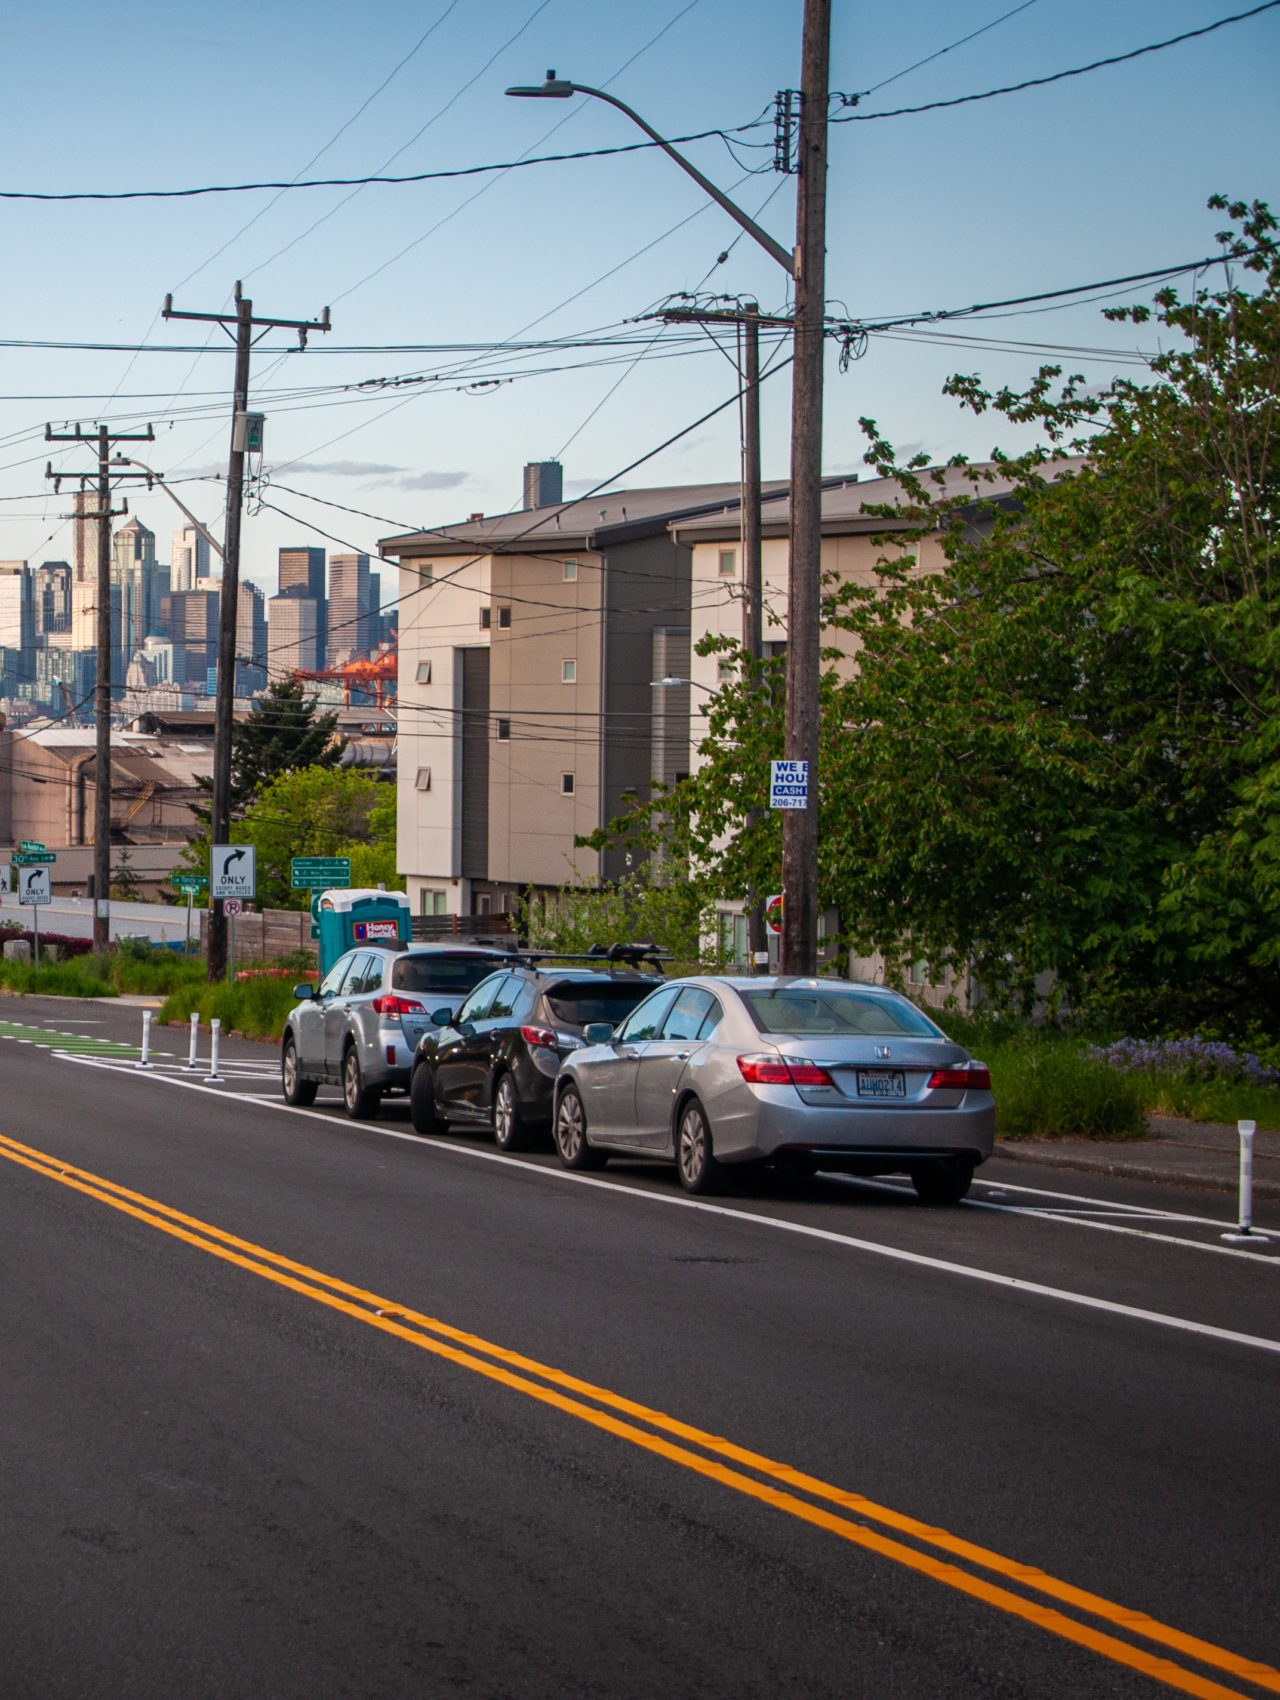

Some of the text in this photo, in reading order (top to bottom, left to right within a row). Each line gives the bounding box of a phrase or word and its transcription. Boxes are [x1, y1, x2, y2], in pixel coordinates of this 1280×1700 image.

[776, 762, 797, 772] WE
[775, 773, 808, 783] HOU
[775, 786, 803, 795] CASH
[220, 875, 246, 884] ONLY
[366, 923, 393, 932] Honey
